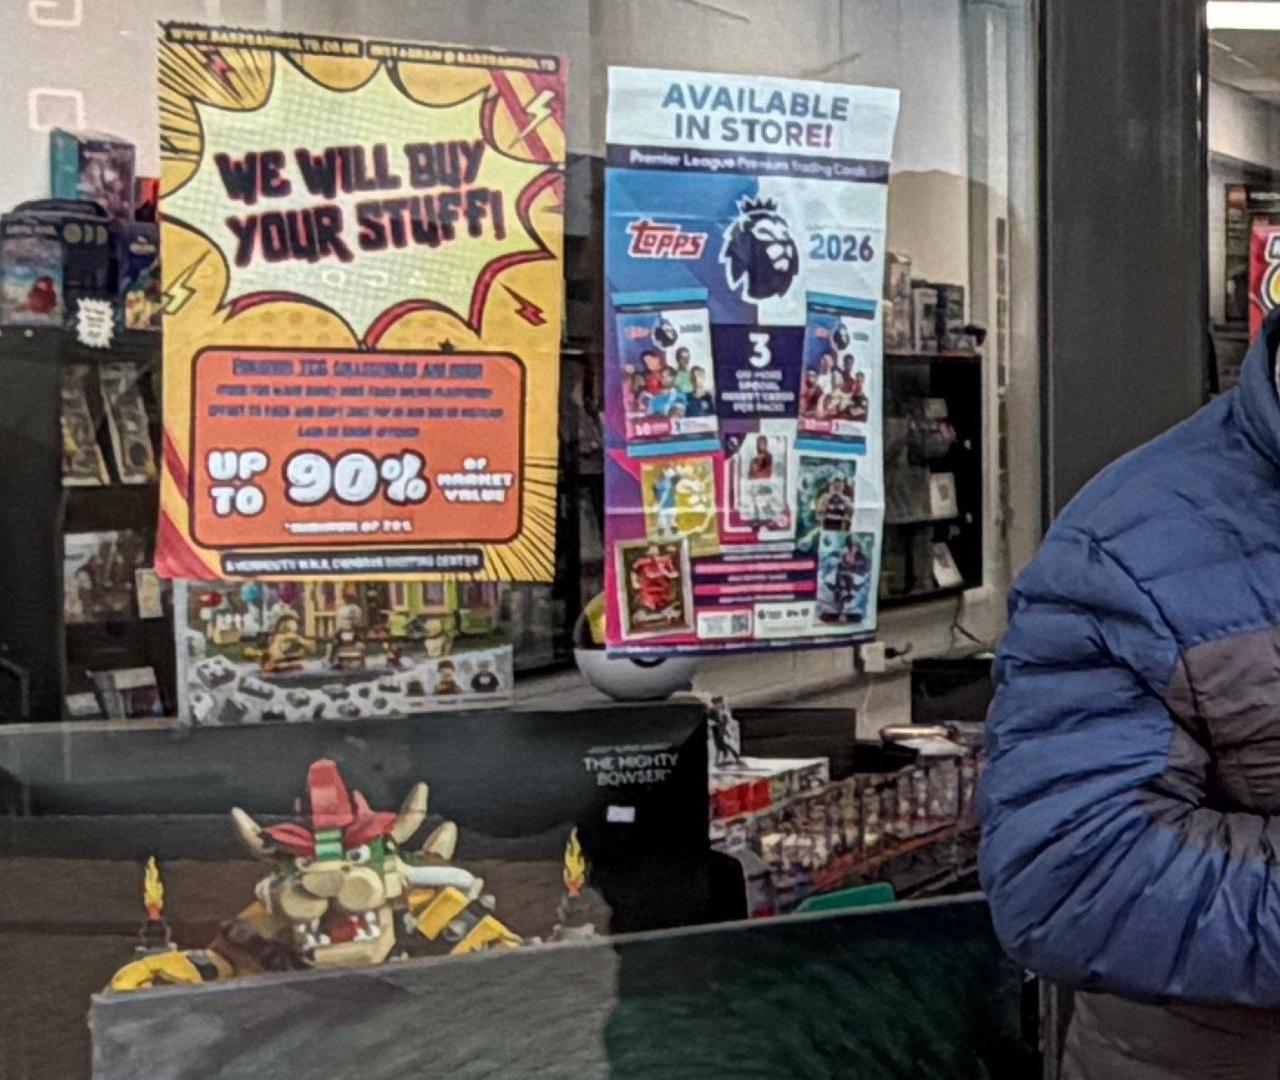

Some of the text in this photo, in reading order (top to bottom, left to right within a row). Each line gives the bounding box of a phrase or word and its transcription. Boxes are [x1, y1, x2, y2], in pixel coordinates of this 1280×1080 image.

[662, 83, 849, 121] AVAILABLE
[675, 115, 833, 148] IN STORE!
[213, 139, 486, 206] WE WILL BUY
[630, 149, 681, 166] Premier
[684, 153, 736, 170] League
[225, 187, 507, 268] YOUR STUFF!
[809, 233, 875, 262] 2026
[749, 333, 771, 369] 3
[207, 450, 429, 504] UP 90%
[209, 485, 265, 517] TO
[582, 753, 679, 771] THE MIGHTY
